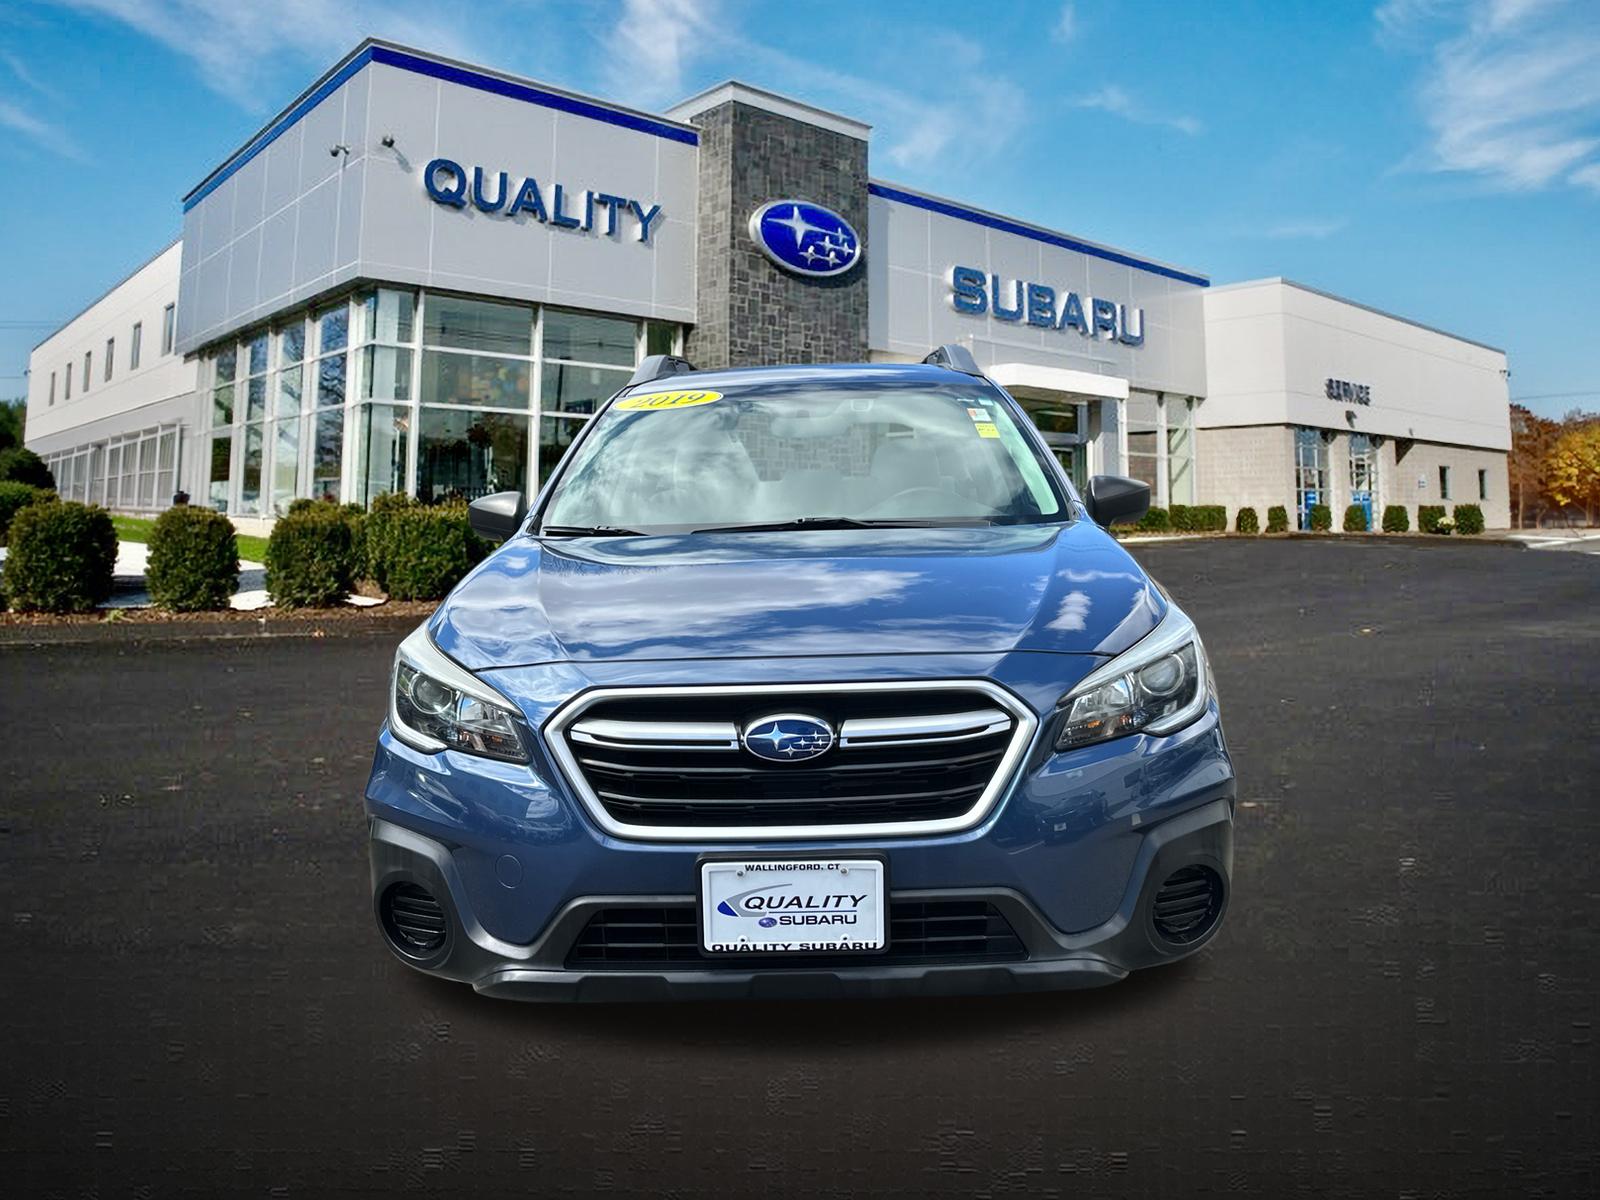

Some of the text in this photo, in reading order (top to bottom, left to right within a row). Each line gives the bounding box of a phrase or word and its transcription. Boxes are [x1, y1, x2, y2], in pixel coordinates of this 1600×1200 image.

[424, 158, 662, 242] QUALITY
[951, 265, 1145, 346] SUBARU
[630, 393, 706, 408] 2019
[744, 895, 867, 909] QUALITY
[779, 915, 857, 925] SUBARU
[712, 942, 878, 951] QUALITY SUBARU
